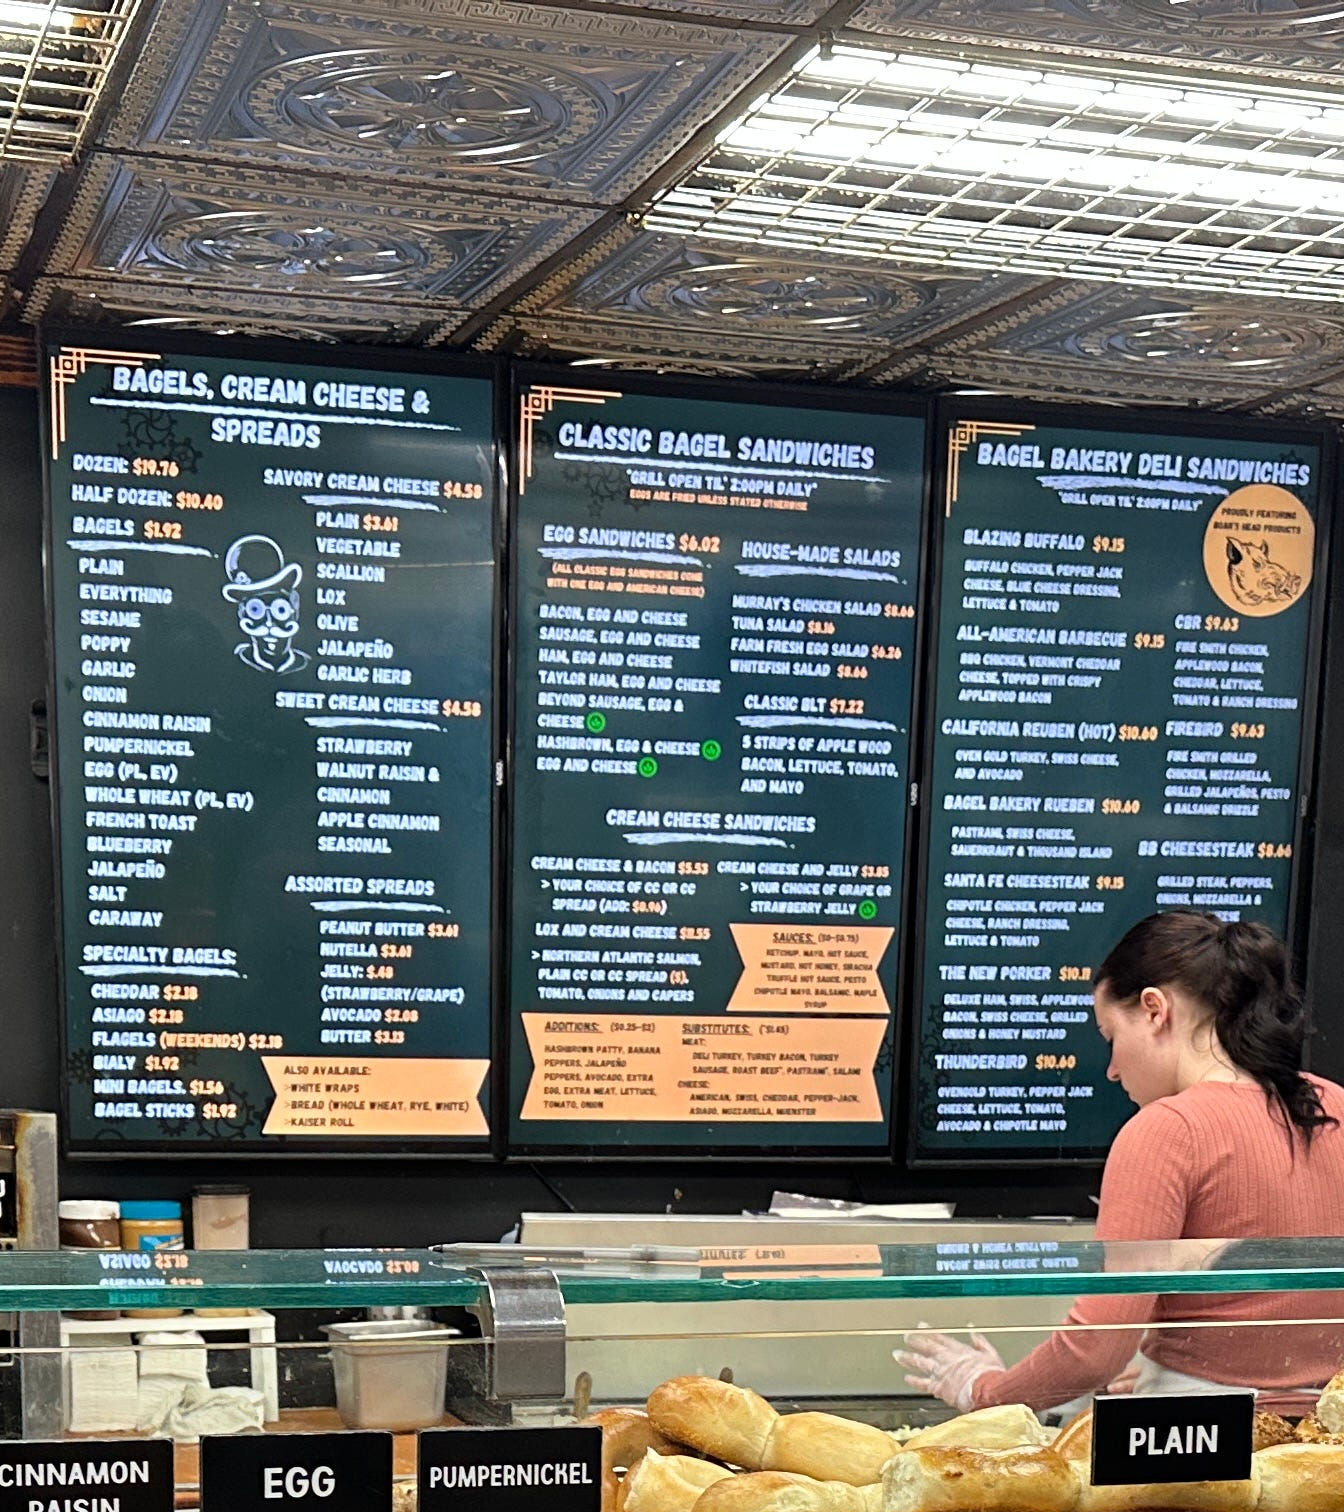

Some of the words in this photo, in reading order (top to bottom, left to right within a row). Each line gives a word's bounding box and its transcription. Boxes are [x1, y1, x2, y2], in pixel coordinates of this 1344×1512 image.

[113, 365, 214, 398] BAGELS,
[220, 374, 306, 405] CREAM
[313, 381, 405, 412] CHEESE
[411, 389, 430, 414] &
[211, 417, 320, 449] SPREADS
[558, 422, 652, 453] CLASSIC
[658, 430, 731, 459] BAGEL
[737, 436, 874, 470] SANDWICHES
[73, 454, 128, 473] DOZEN:
[132, 457, 179, 478] $19.76
[977, 441, 1044, 468] BAGEL
[1050, 447, 1132, 474] BAKERY
[1137, 452, 1182, 477] DELI
[1186, 456, 1309, 490] SANDWICHES
[263, 468, 323, 488] SAVORY
[327, 472, 380, 492] CREAM
[382, 476, 441, 496] CHEESE
[442, 480, 482, 500] $4.58
[71, 484, 113, 503] HALF
[117, 487, 172, 507] DOZEN:
[176, 490, 223, 511] $10.40
[73, 516, 134, 536] BAGELS
[316, 510, 359, 529] PLAIN
[362, 513, 398, 533] $3.61
[316, 536, 401, 558] VEGETABLE
[543, 524, 574, 543] EGG
[578, 526, 675, 550] SANDWICHES
[678, 533, 720, 554] $6.02
[963, 528, 1021, 547] BLAZING
[1023, 532, 1085, 550] BUFFALO
[1092, 534, 1124, 554] $9.15
[742, 541, 840, 563] HOUSE-MADE
[843, 547, 900, 567] SALADS
[79, 557, 124, 575] PLAIN
[316, 562, 385, 582] SCALLION
[79, 583, 172, 604] EVERYTHING
[316, 587, 346, 605] LOX
[539, 603, 584, 621] BACON,
[586, 606, 611, 622] EGG
[613, 608, 638, 623] AND
[641, 610, 687, 626] CHEESE
[732, 594, 790, 611] MURRAY'S
[792, 598, 841, 614] CHICKEN
[843, 601, 881, 616] SALAD
[883, 602, 914, 619] $8.66
[80, 609, 140, 627] SESAME
[317, 613, 358, 632] OLIVE
[1174, 614, 1201, 630] CBR
[1204, 614, 1239, 632] $9.63
[81, 634, 130, 653] POPPY
[317, 637, 393, 658] JALAPEÑO
[539, 626, 598, 643] SAUSAGE,
[599, 629, 624, 644] EGG
[626, 631, 651, 646] AND
[654, 633, 700, 649] CHEESE
[956, 625, 1056, 644] ALL-AMERICAN
[1058, 629, 1127, 647] BARBECUE
[1133, 632, 1165, 650] $9.15
[81, 659, 136, 678] GARLIC
[317, 664, 369, 683] GARLIC
[372, 667, 411, 685] HERB
[538, 669, 586, 686] TAYLOR
[588, 672, 619, 688] HAM,
[621, 674, 645, 689] EGG
[647, 675, 673, 691] AND
[675, 677, 721, 693] CHEESE
[82, 685, 127, 703] ONION
[275, 691, 325, 709] SWEET
[328, 693, 380, 712] CREAM
[383, 696, 439, 715] CHEESE
[442, 699, 481, 718] $4.58
[744, 694, 798, 711] CLASSIC
[800, 696, 827, 712] BLT
[829, 697, 864, 715] $7.22
[82, 710, 159, 730] CINNAMON
[162, 714, 210, 733] RAISIN
[941, 718, 1019, 736] CALIFORNIA
[1022, 721, 1075, 738] REUBEN
[1078, 721, 1116, 742] (HOT)
[1118, 724, 1158, 742] $10.60
[1165, 720, 1223, 737] FIREBIRD
[1230, 721, 1265, 739] $9.63
[83, 736, 194, 756] PUMPERNICKEL
[316, 736, 412, 756] STRAWBERRY
[943, 794, 986, 810] BAGEL
[989, 796, 1041, 812] BAKERY
[1043, 797, 1095, 813] RUEBEN
[1101, 797, 1140, 815] $10.60
[86, 811, 145, 828] FRENCH
[148, 813, 197, 831] TOAST
[606, 808, 660, 827] CREAM
[662, 811, 721, 829] CHEESE
[724, 813, 815, 832] SANDWICHES
[86, 836, 172, 854] BLUEBERRY
[1138, 840, 1158, 856] BB
[1160, 840, 1254, 857] CHEESESTEAK
[1257, 842, 1291, 859] $8.66
[284, 875, 363, 893] ASSORTED
[366, 878, 434, 896] SPREADS
[944, 873, 985, 887] SANTA
[987, 874, 1004, 888] FE
[1006, 874, 1090, 889] CHEESESTEAK
[1095, 875, 1124, 890] $9.15
[88, 885, 127, 901] SALT
[88, 909, 163, 927] CARAWAY
[83, 944, 168, 963] SPECIALTY
[172, 947, 236, 965] BAGELS:
[939, 965, 966, 980] THE
[968, 965, 997, 980] NEW
[1000, 965, 1051, 980] PORKER
[92, 1007, 145, 1023] ASIAGO
[320, 1007, 382, 1022] AVOCADO
[283, 1065, 308, 1074] ALSO
[312, 1066, 370, 1075] AVAILABLE:
[934, 1054, 1027, 1069] THUNDERBIRD
[1034, 1054, 1076, 1070] $10.60
[94, 1102, 142, 1117] BAGEL
[145, 1103, 195, 1118] STICKS
[1129, 1425, 1218, 1455] PLAIN
[264, 1466, 335, 1498] EGG
[430, 1463, 592, 1488] PUMPERNICKEL
